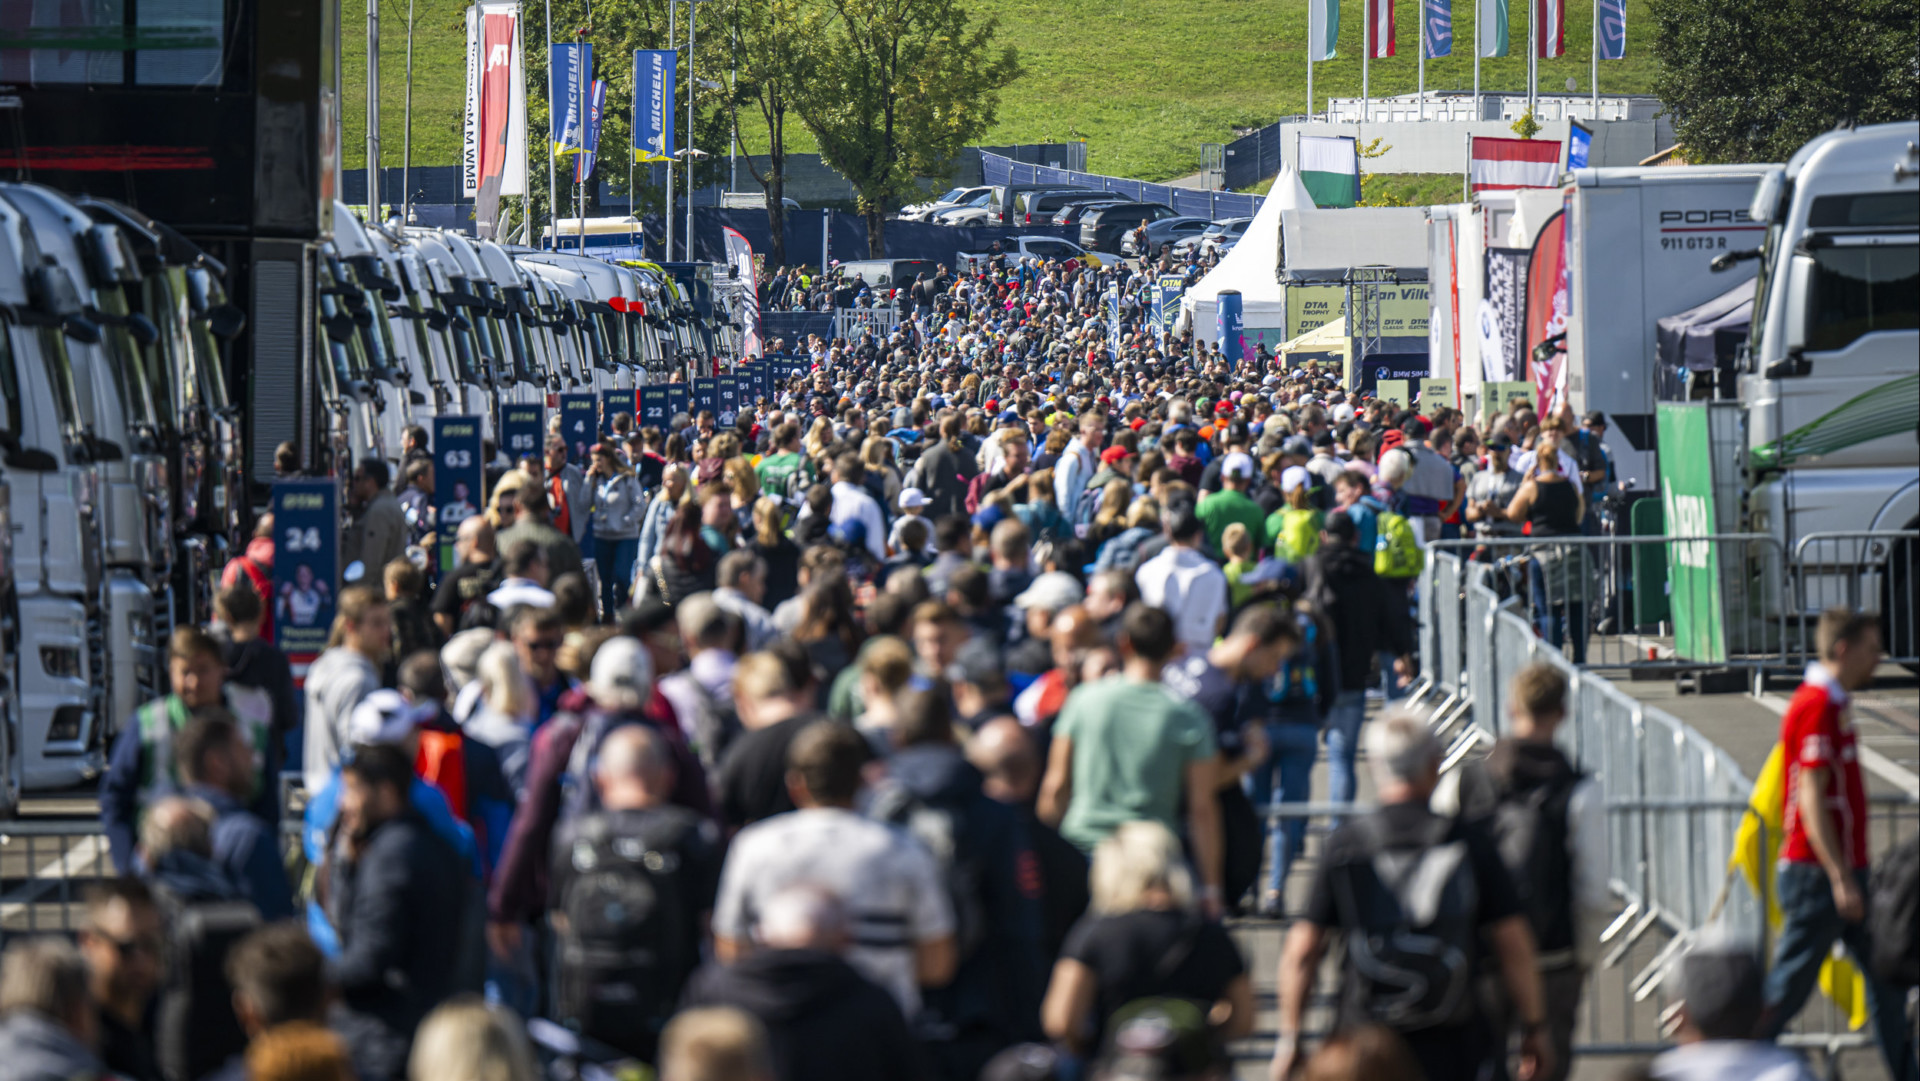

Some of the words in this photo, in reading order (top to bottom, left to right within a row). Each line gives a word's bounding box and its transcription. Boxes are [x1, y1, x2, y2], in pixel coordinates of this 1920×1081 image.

[567, 46, 579, 124] MICHELIN
[650, 53, 663, 132] MICHELIN
[1660, 209, 1757, 223] PORS
[1661, 237, 1683, 250] 911
[1686, 237, 1714, 250] GT3
[1717, 237, 1727, 249] R
[1162, 279, 1182, 287] DTM
[1368, 289, 1396, 301] Fan
[1304, 301, 1328, 309] DTM
[1501, 258, 1517, 368] PERFORMANCE
[1300, 320, 1324, 328] DTM
[739, 382, 749, 390] 51
[609, 395, 630, 404] DTM
[645, 391, 665, 399] DTM
[701, 396, 711, 405] 11
[722, 391, 734, 400] 18
[567, 401, 591, 410] DTM
[509, 412, 536, 422] DTM
[647, 407, 663, 417] 22
[442, 424, 474, 438] DTM
[573, 420, 586, 433] 4
[511, 434, 534, 449] 85
[444, 450, 472, 468] 63
[281, 492, 325, 510] DTM
[285, 526, 321, 551] 24
